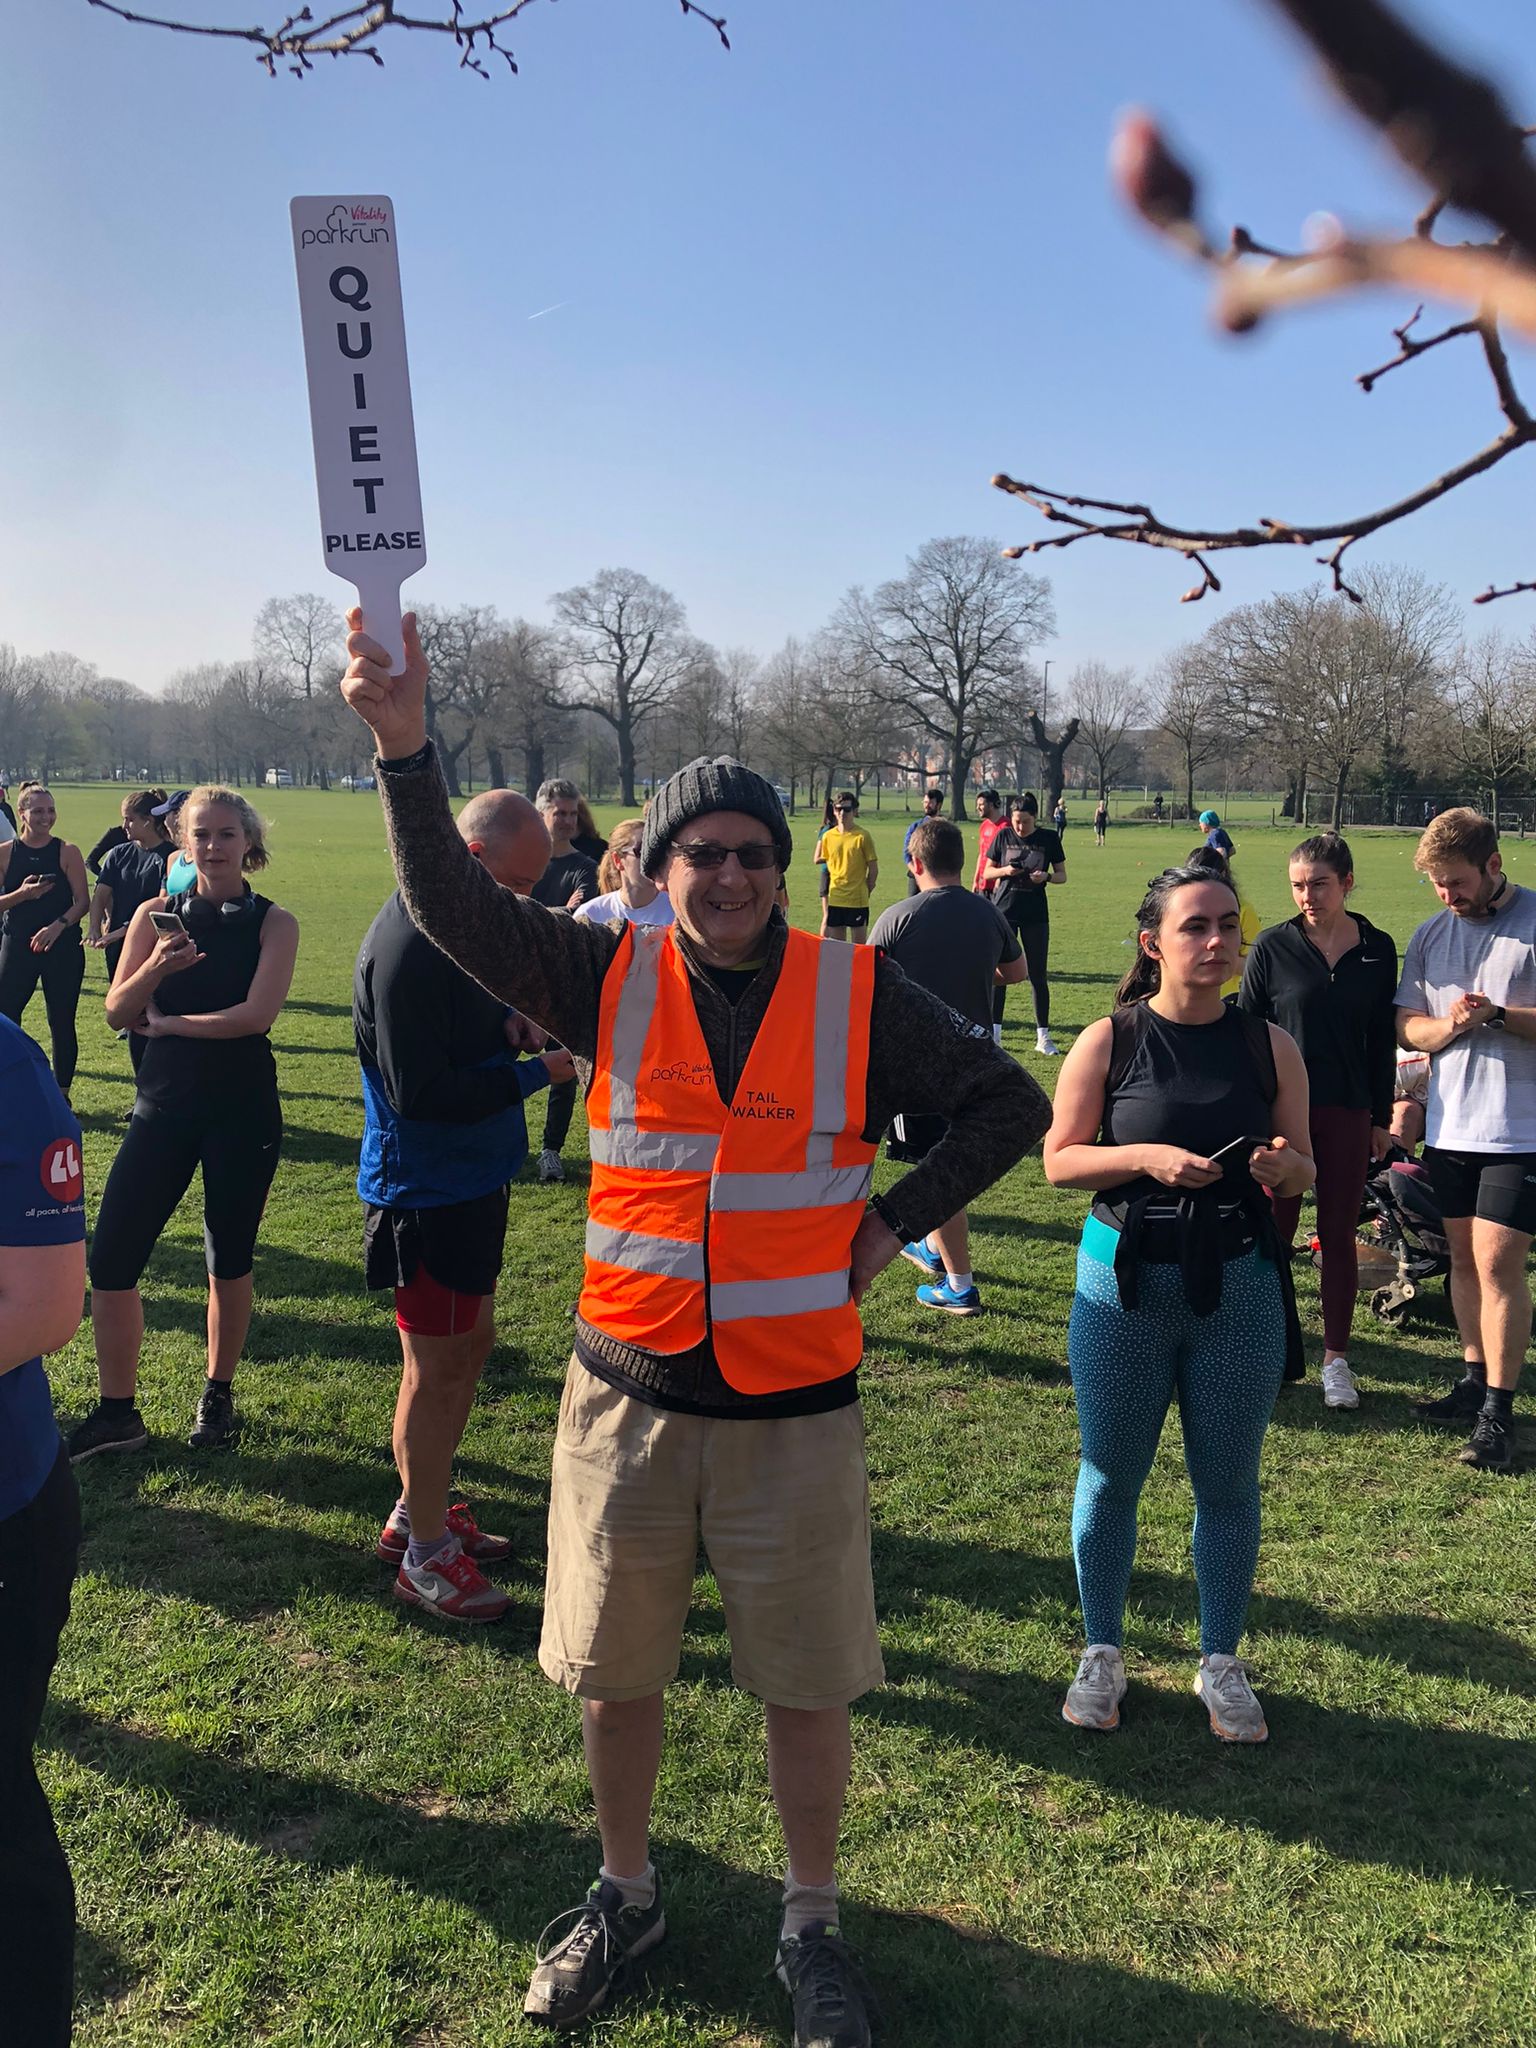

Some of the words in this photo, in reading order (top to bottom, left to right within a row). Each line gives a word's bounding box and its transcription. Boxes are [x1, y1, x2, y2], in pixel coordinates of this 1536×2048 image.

[351, 204, 387, 224] Vitality
[302, 219, 389, 249] parkrun
[329, 265, 384, 514] QUIET
[326, 531, 422, 553] PLEASE
[650, 1067, 711, 1085] parkrun
[746, 1091, 779, 1104] TAIL
[731, 1106, 796, 1120] WALKER
[25, 1208, 35, 1217] all
